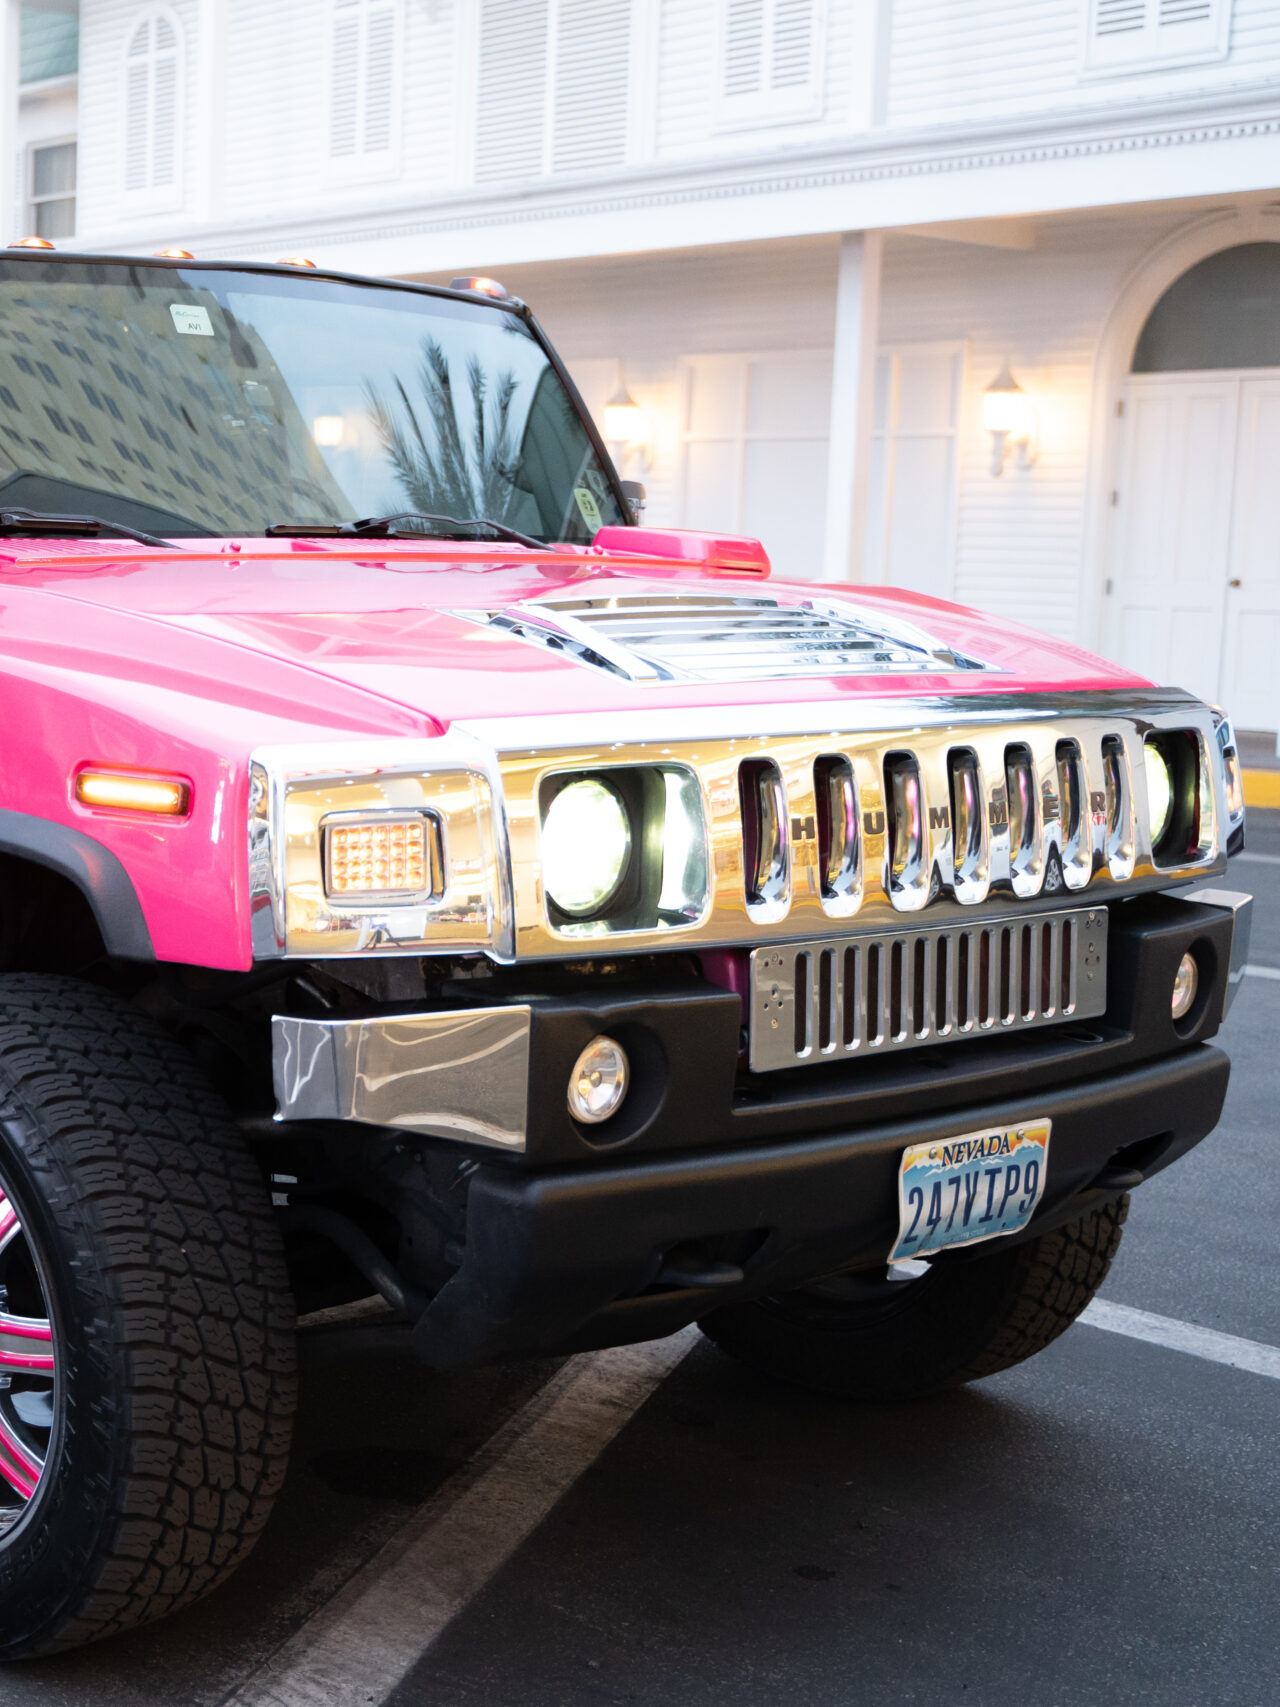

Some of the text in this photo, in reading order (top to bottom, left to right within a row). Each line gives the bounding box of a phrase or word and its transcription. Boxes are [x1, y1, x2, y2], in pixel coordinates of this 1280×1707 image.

[791, 792, 1106, 841] HUMMER
[941, 1133, 1011, 1167] NEVADA
[902, 1160, 1040, 1244] 247VIP9
